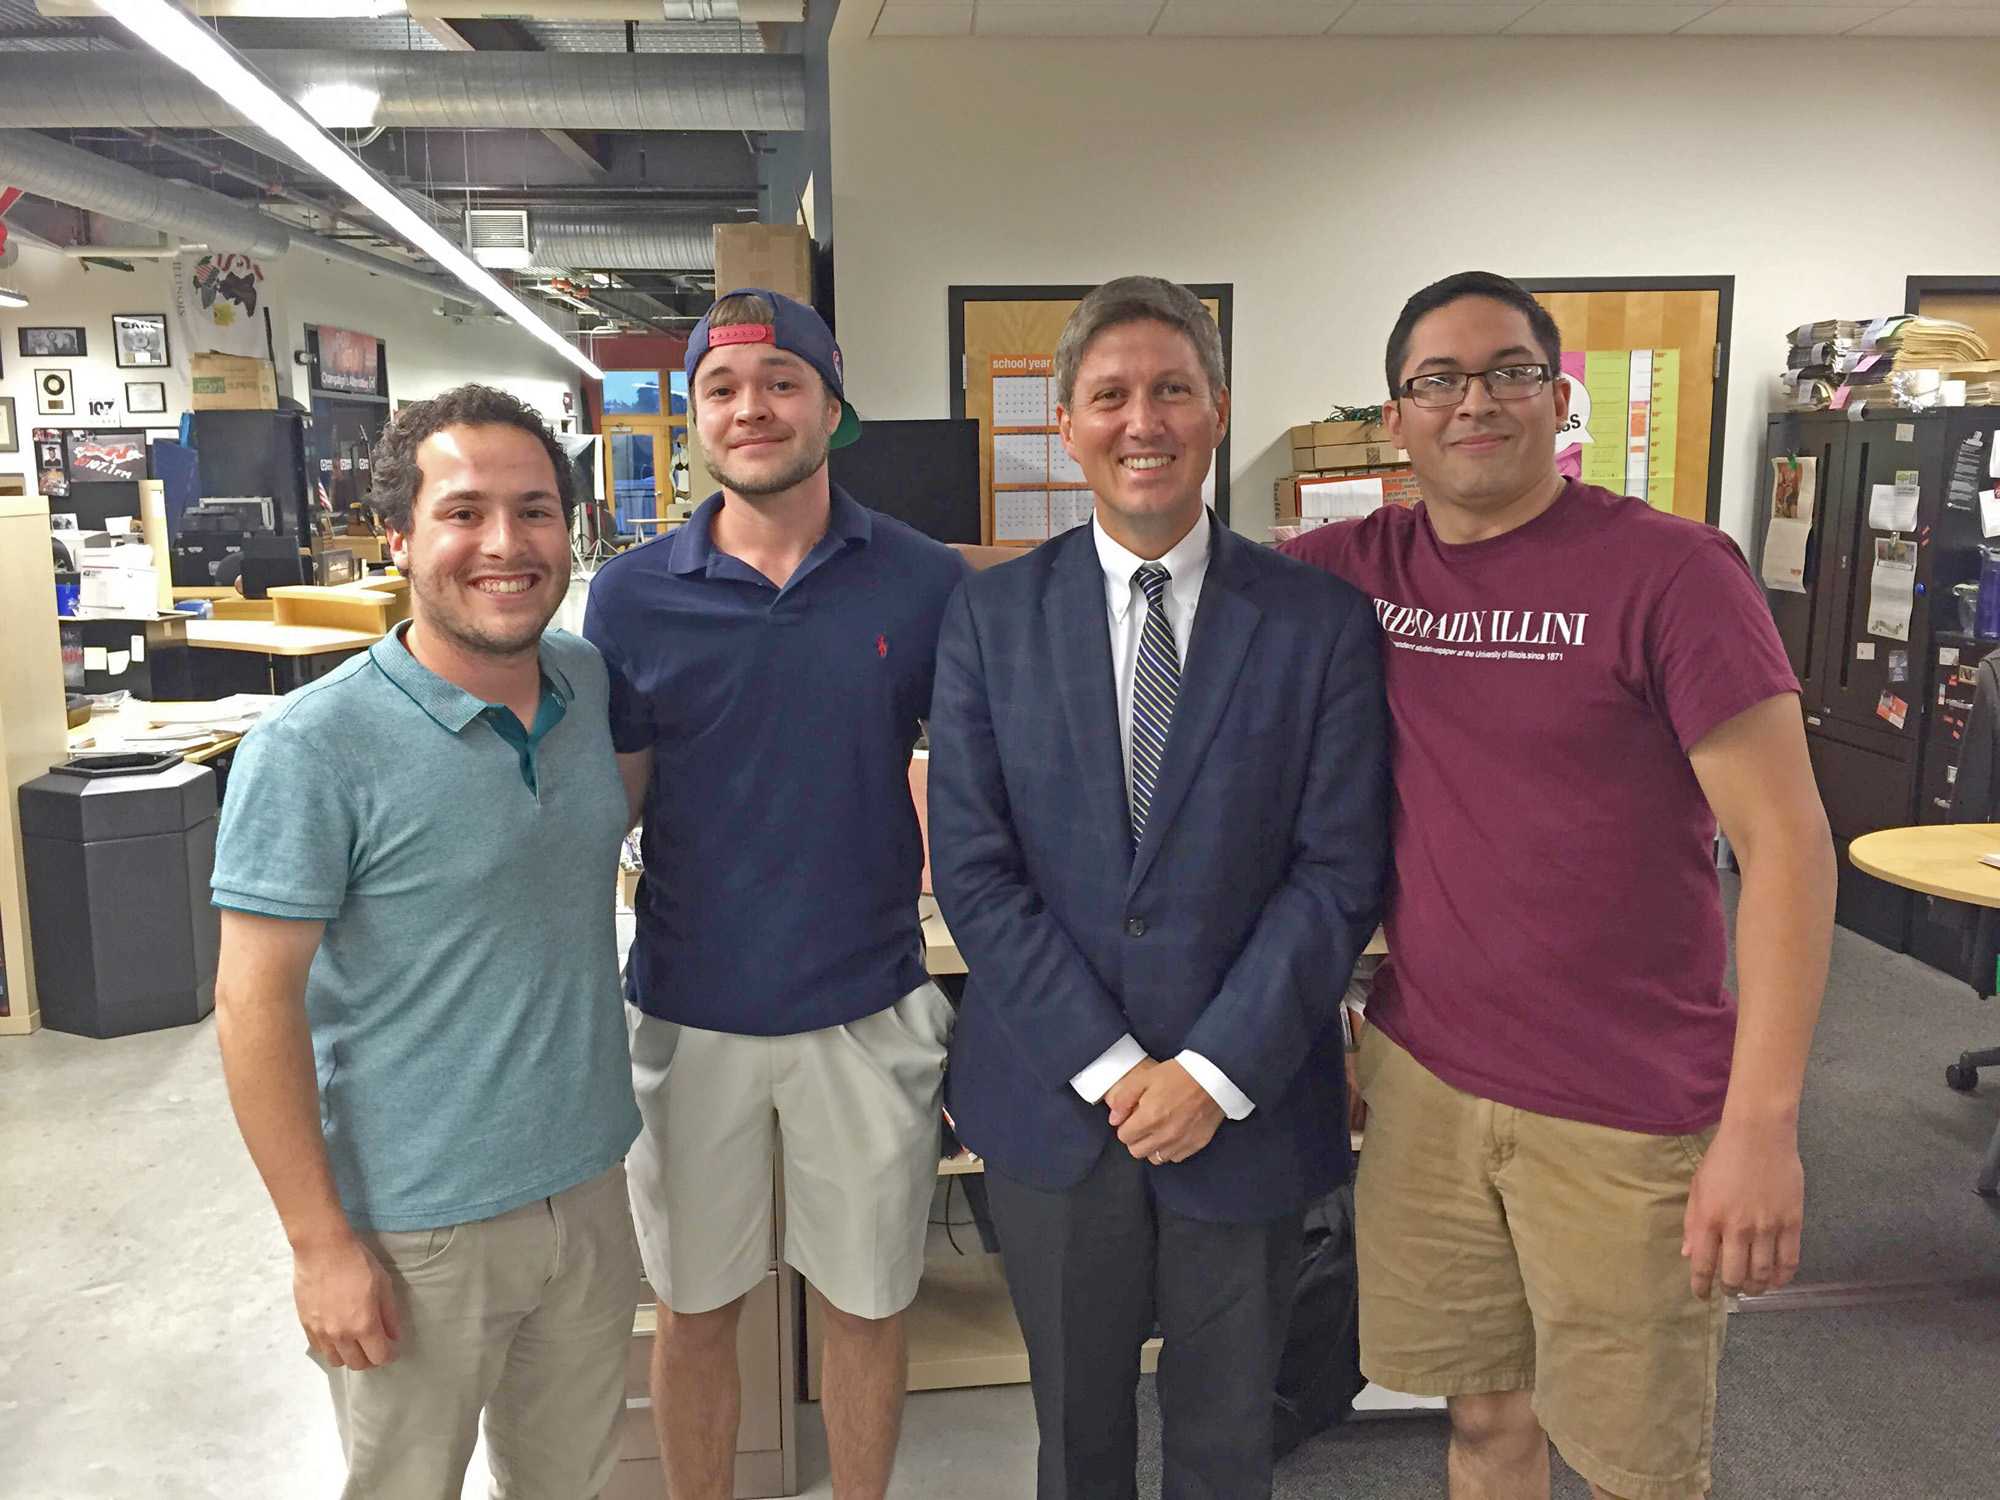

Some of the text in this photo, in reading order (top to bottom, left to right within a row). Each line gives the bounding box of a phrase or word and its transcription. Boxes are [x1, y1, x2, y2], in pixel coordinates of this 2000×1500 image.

[992, 358, 1026, 369] school
[1028, 359, 1051, 370] year
[85, 459, 117, 475] 107.1
[113, 468, 132, 479] FM
[1491, 610, 1590, 646] ILLINI
[1547, 652, 1563, 661] 1871
